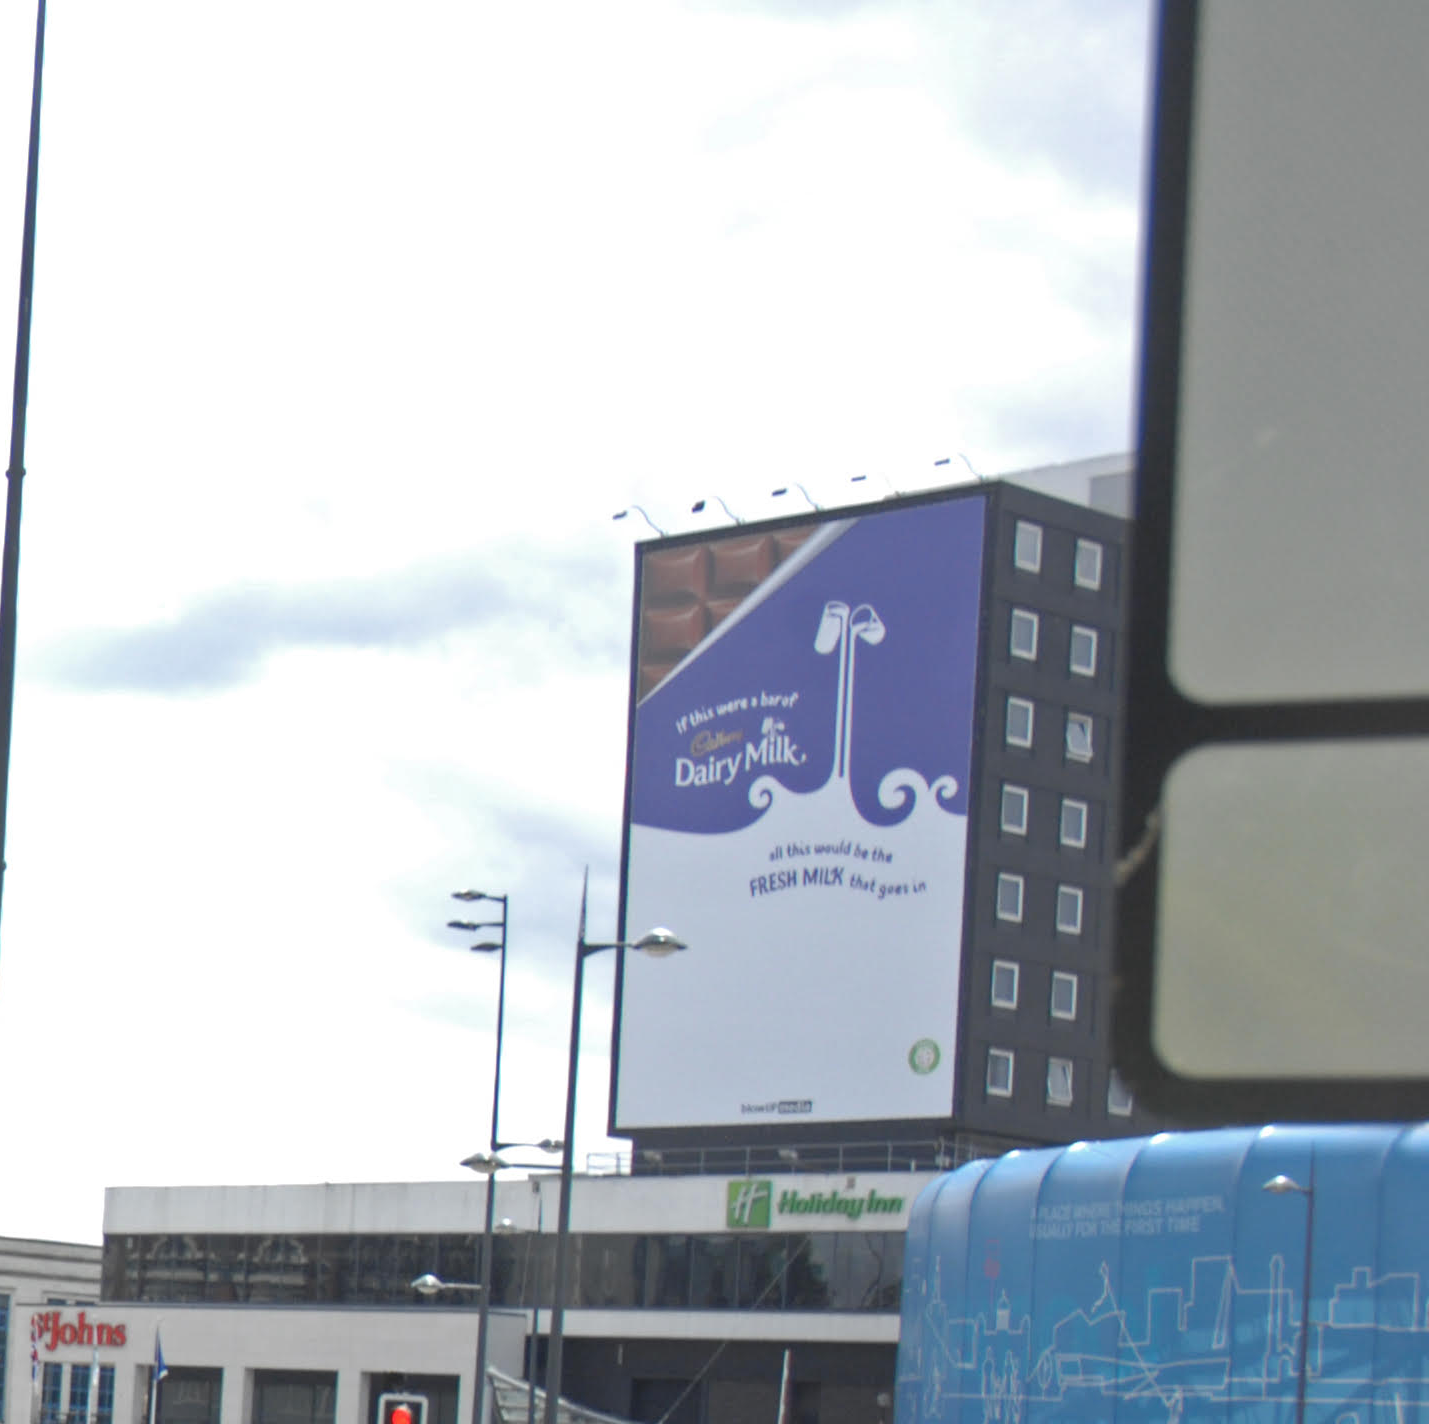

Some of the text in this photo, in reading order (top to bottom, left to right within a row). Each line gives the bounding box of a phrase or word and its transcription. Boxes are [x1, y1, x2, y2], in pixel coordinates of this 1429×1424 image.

[674, 752, 743, 787] Dairy
[769, 839, 893, 864] all this would be the
[749, 866, 927, 901] FRESH MILK that goes in
[777, 1189, 903, 1220] Holiday Inn
[46, 1311, 127, 1351] Johns
